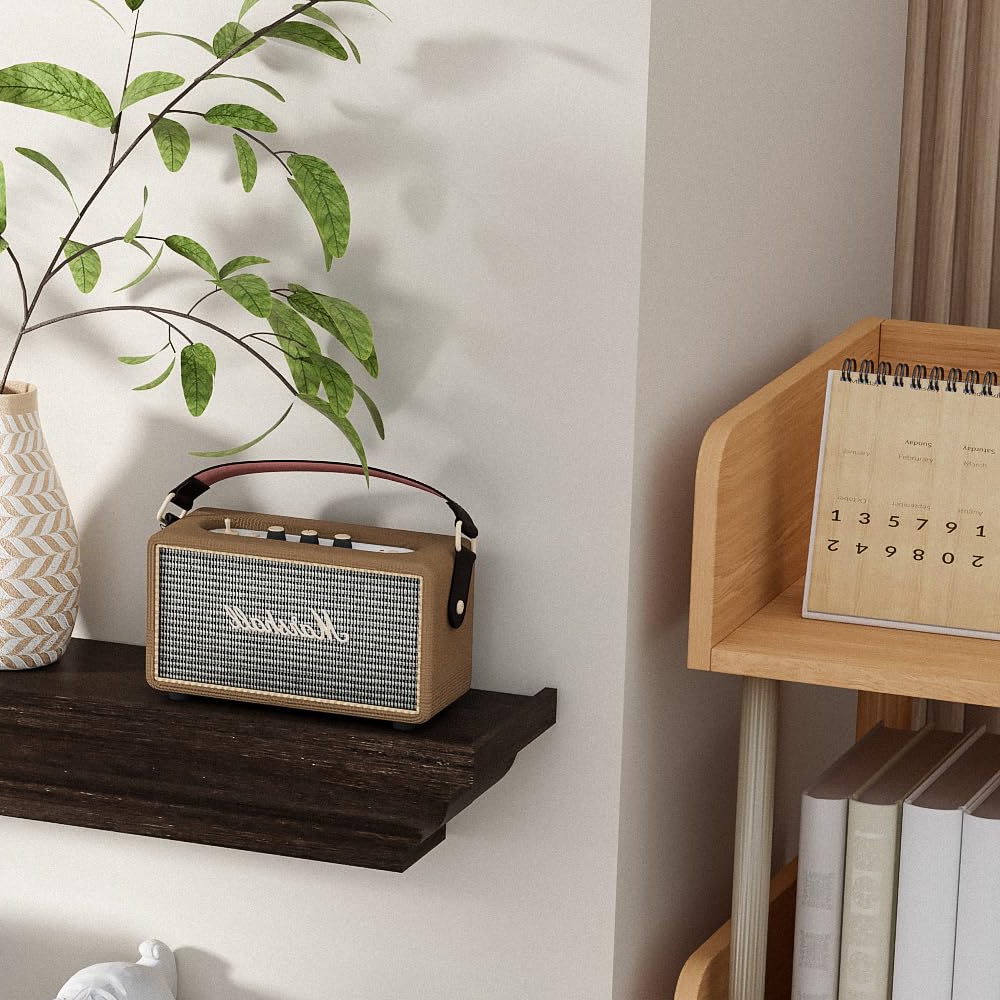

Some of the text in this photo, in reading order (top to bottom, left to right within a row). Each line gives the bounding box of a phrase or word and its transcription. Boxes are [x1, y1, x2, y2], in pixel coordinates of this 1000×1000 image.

[904, 439, 996, 455] Saturday Sunday
[831, 509, 986, 538] 1 3 5 7 9 1
[827, 539, 840, 552] 2
[855, 542, 869, 555] 4
[912, 548, 925, 561] 8
[971, 555, 985, 568] 2
